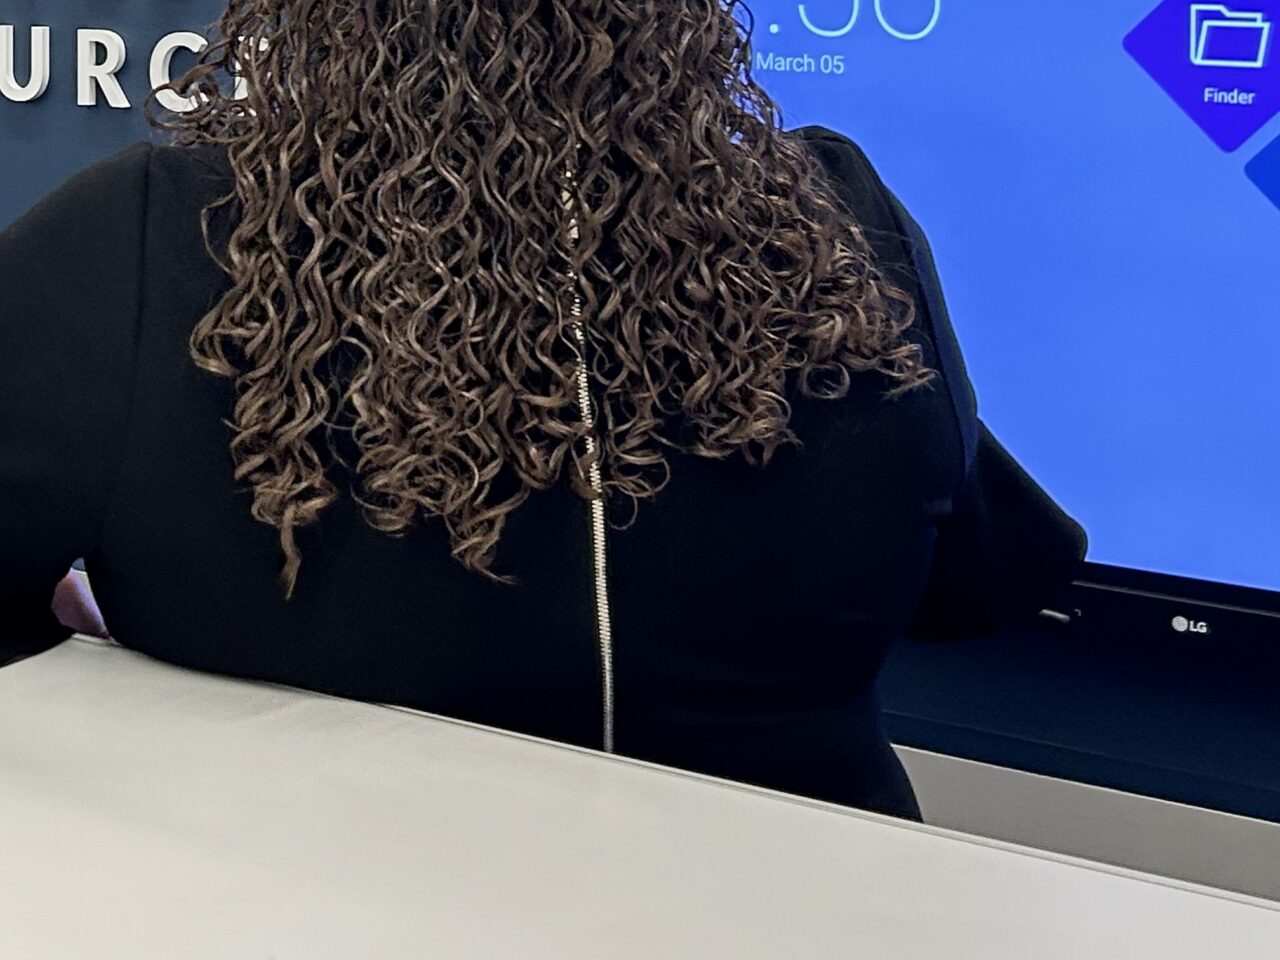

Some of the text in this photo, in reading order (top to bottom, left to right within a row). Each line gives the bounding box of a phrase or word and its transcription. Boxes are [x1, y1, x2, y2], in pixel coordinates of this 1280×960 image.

[756, 52, 844, 74] March 05
[1204, 87, 1255, 105] Finder
